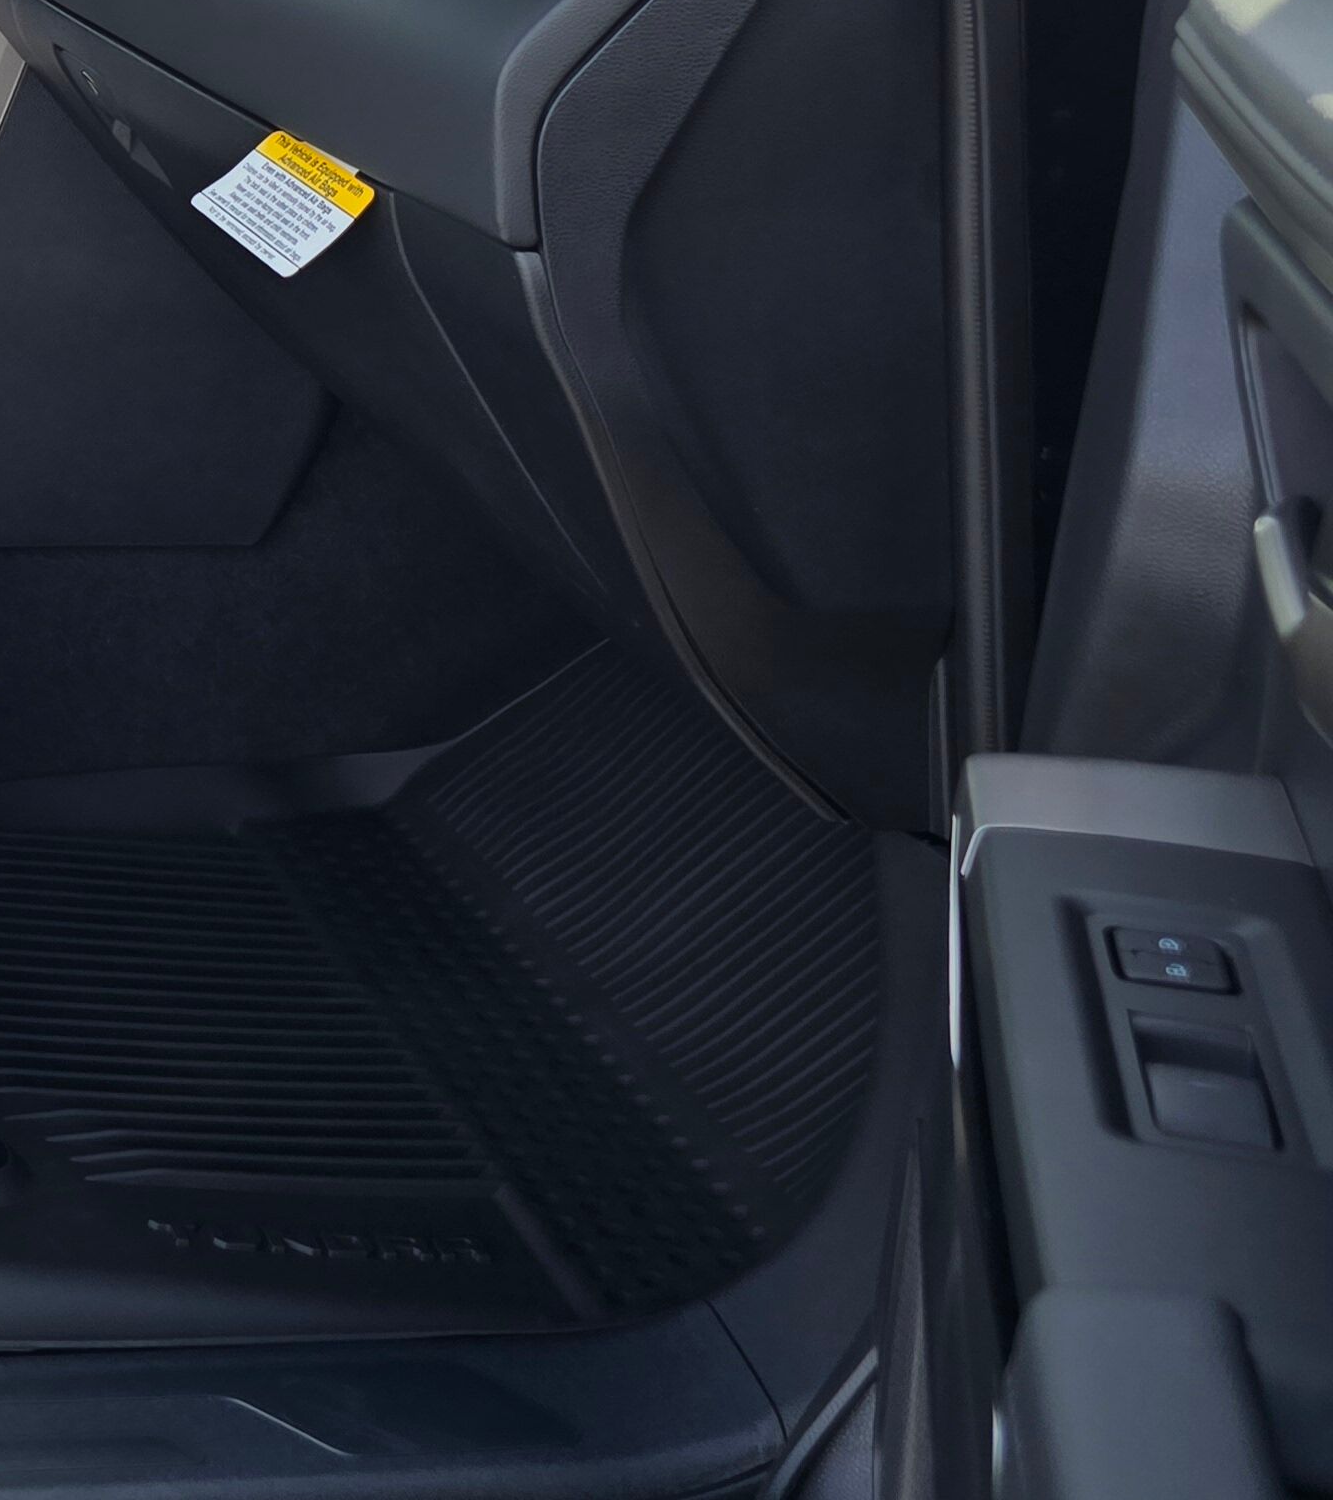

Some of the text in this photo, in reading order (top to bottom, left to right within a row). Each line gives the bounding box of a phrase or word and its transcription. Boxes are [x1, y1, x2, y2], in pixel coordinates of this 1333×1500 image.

[261, 162, 332, 214] Even with Advanced Air Bags
[276, 135, 364, 197] This Vehicle is Equipped with
[278, 154, 338, 197] Advanced Air Bags
